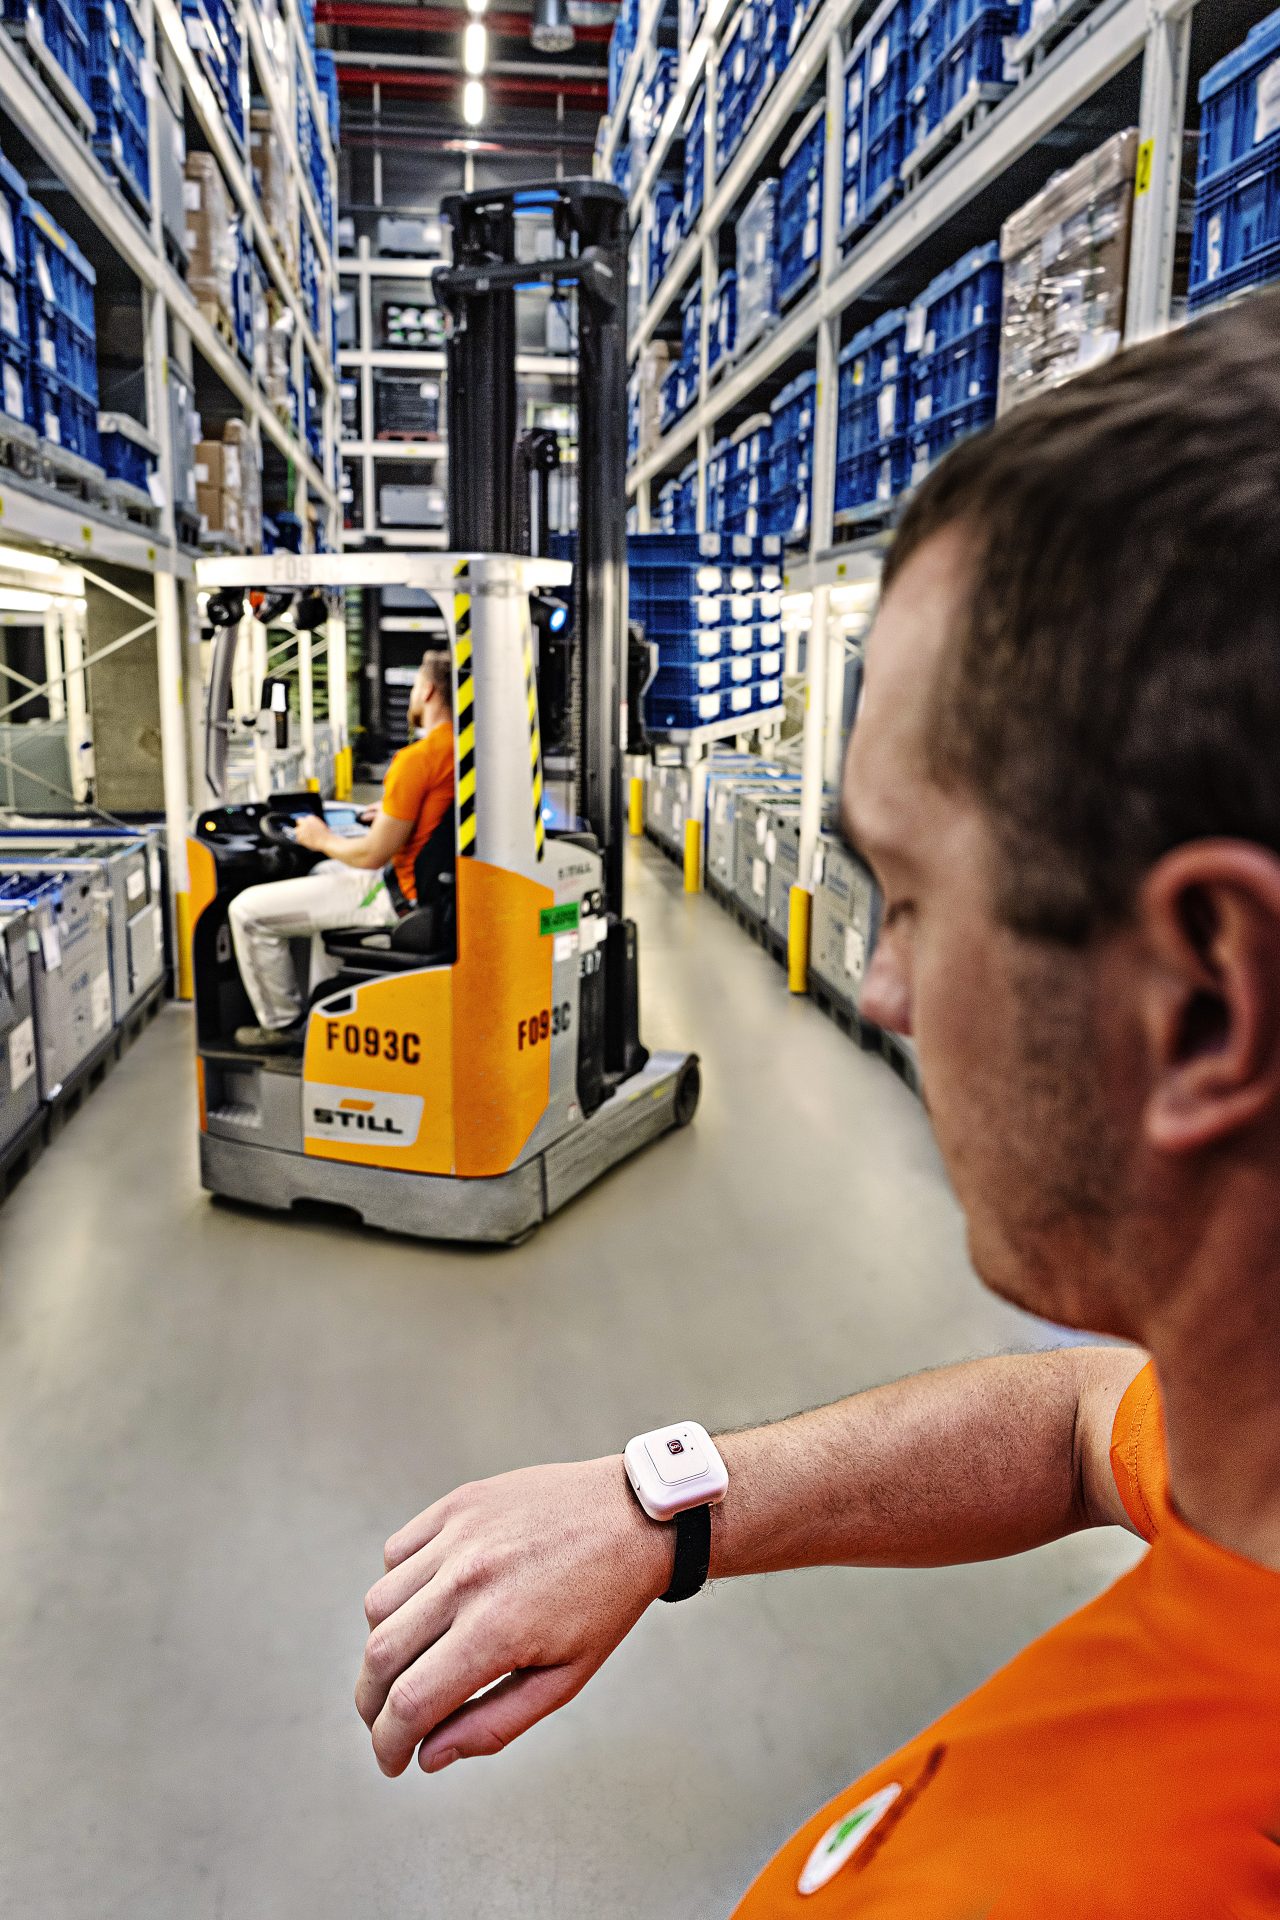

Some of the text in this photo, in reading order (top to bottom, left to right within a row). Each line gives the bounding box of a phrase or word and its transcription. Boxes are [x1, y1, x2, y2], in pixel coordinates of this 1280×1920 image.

[326, 1021, 421, 1065] F093C
[517, 1001, 572, 1051] F093C
[313, 1108, 403, 1135] STILL
